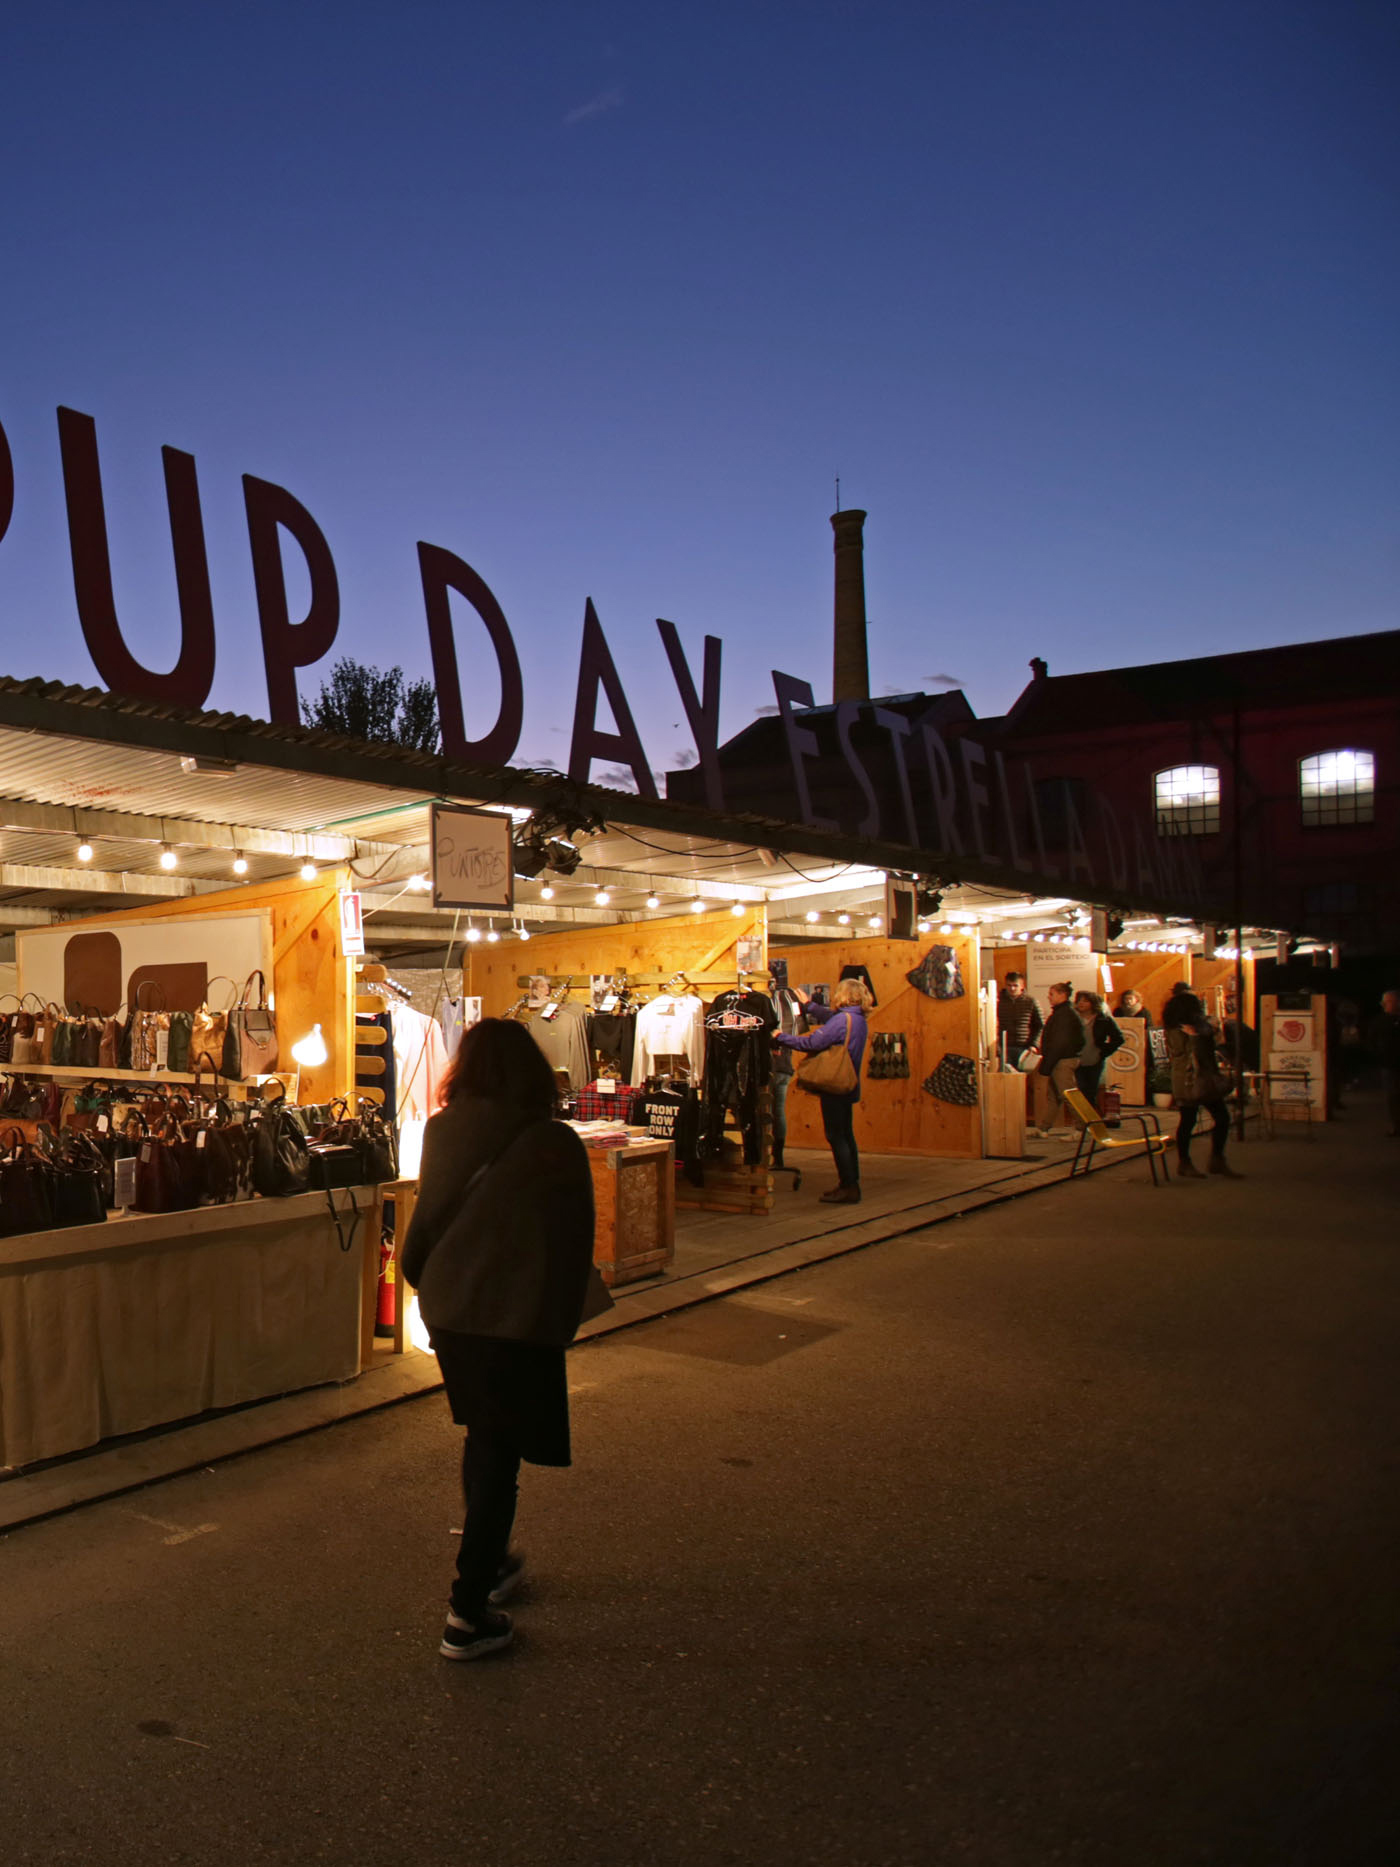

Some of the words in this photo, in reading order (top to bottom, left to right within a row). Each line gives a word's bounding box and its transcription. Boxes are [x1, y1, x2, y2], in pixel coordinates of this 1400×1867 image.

[416, 540, 725, 811] DAY
[771, 669, 1096, 886] ESTRELLA
[645, 1103, 680, 1116] FRONT
[650, 1115, 674, 1126] ROW
[649, 1125, 674, 1136] ONLY
